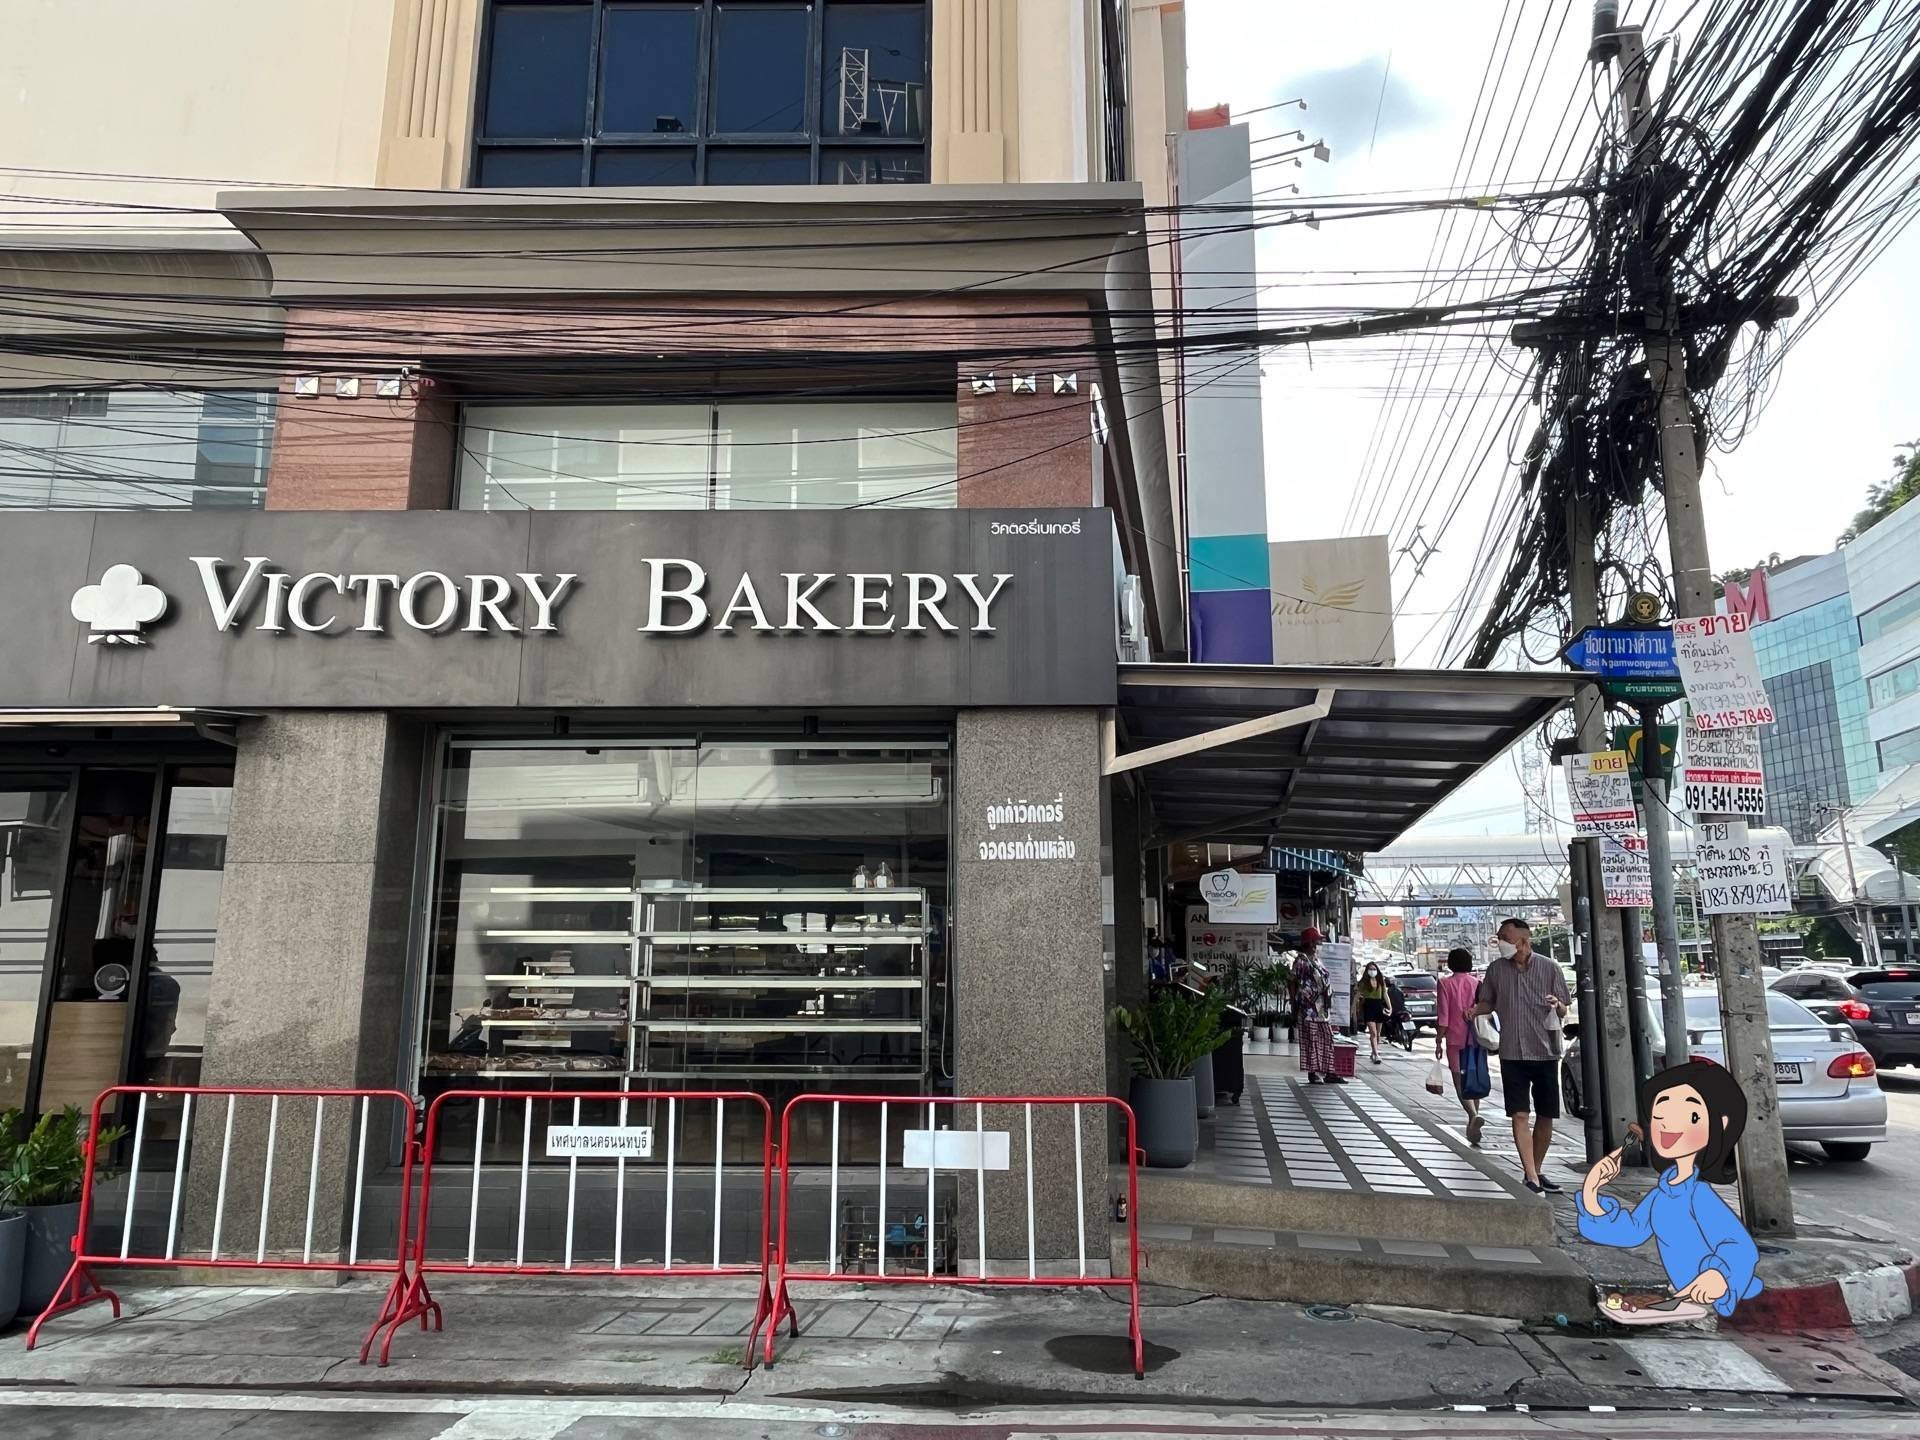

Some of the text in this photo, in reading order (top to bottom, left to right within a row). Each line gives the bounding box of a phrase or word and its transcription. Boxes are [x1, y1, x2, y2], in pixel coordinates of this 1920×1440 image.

[990, 517, 1082, 535] วิคตอรี่เบเกอรี่
[189, 556, 1015, 634] VICTORY BAKERY
[1699, 614, 1747, 637] ขาย
[1585, 658, 1600, 668] Soi
[1696, 707, 1774, 730] 02-115-7849
[1594, 757, 1623, 771] ขาย
[1686, 785, 1764, 813] 091-541-5556
[1575, 820, 1636, 832] 094-876-5544
[1701, 824, 1729, 841] ขาย
[979, 833, 1076, 860] จอดรถด้านหลัง
[1728, 846, 1751, 862] 108
[551, 1129, 648, 1156] เทศบาลนครนนทบุรี
